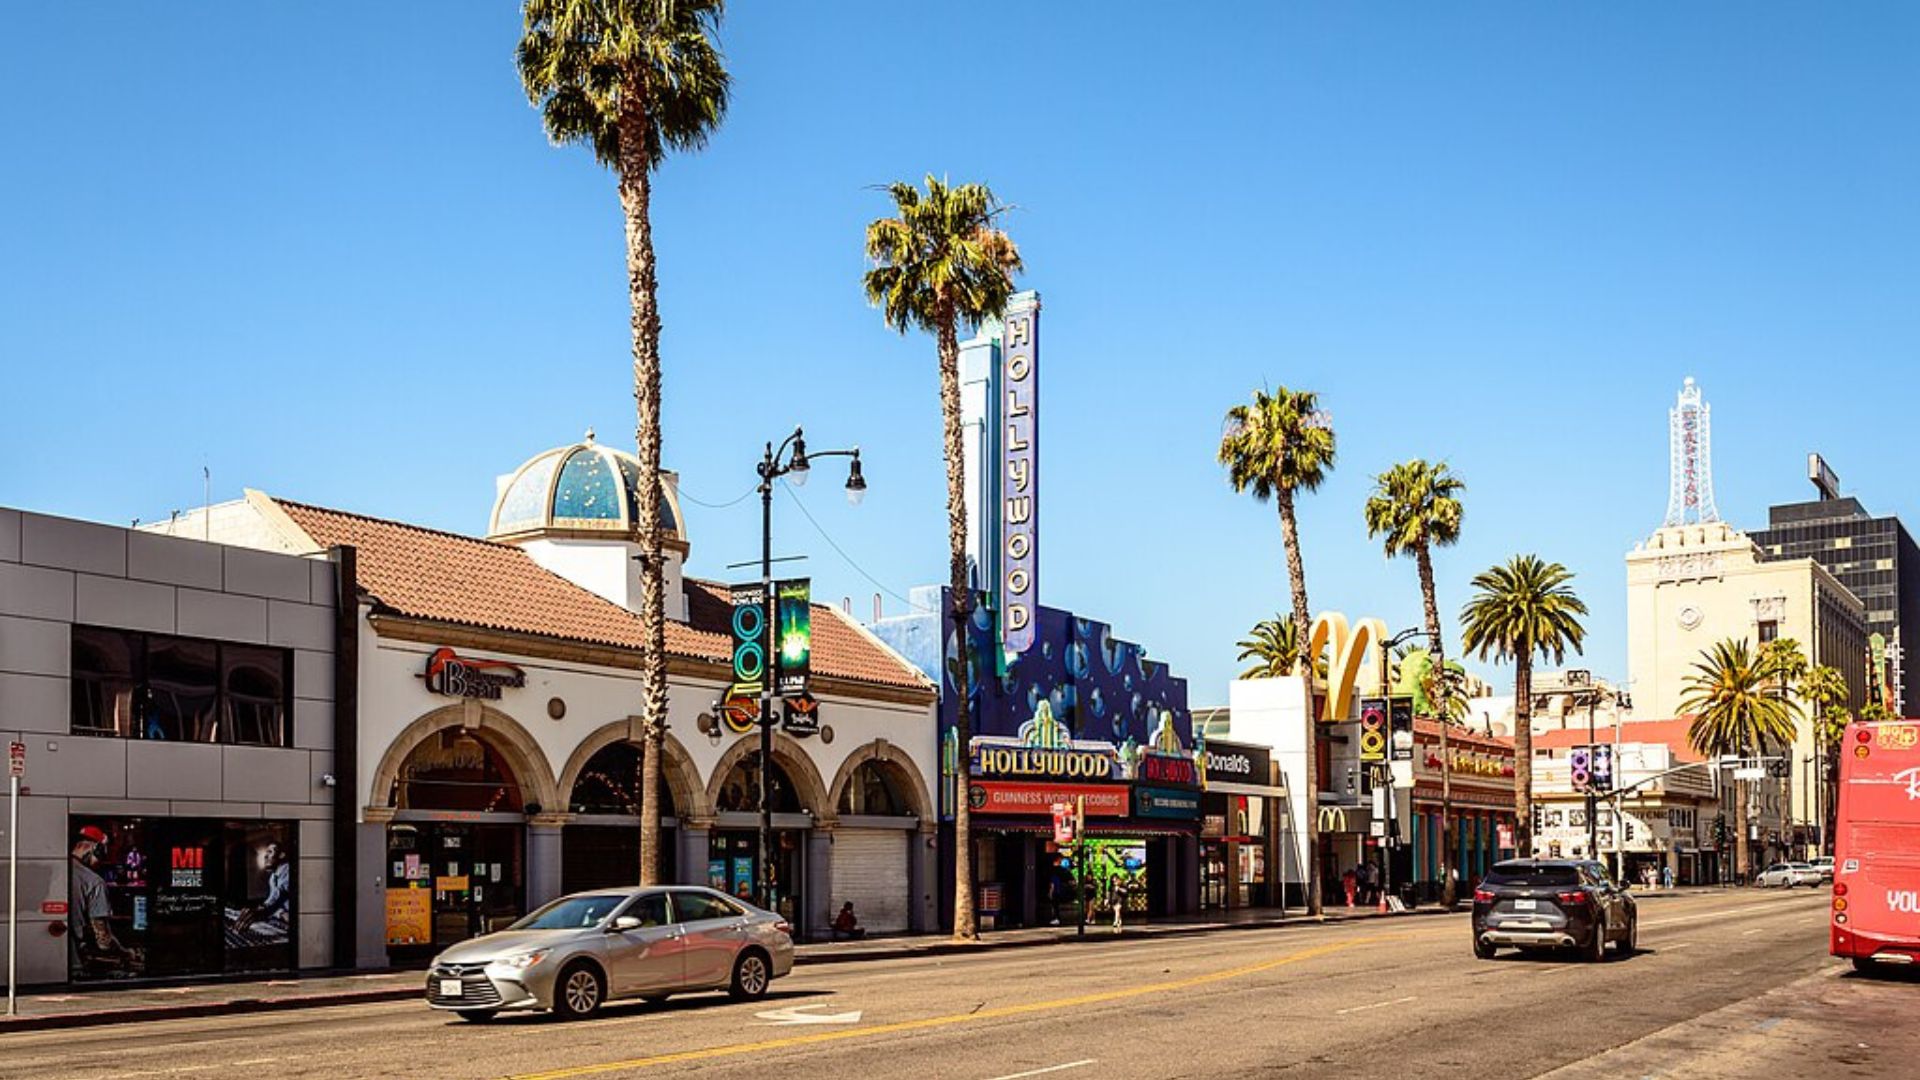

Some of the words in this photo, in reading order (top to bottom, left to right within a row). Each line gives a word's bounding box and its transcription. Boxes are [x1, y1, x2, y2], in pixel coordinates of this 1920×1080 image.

[1007, 318, 1030, 632] HOLLYWOOD
[981, 749, 1110, 777] HOLLYWOOD
[993, 791, 1042, 804] GUINNESS
[1084, 795, 1120, 807] ECORDS
[172, 847, 203, 869] MI
